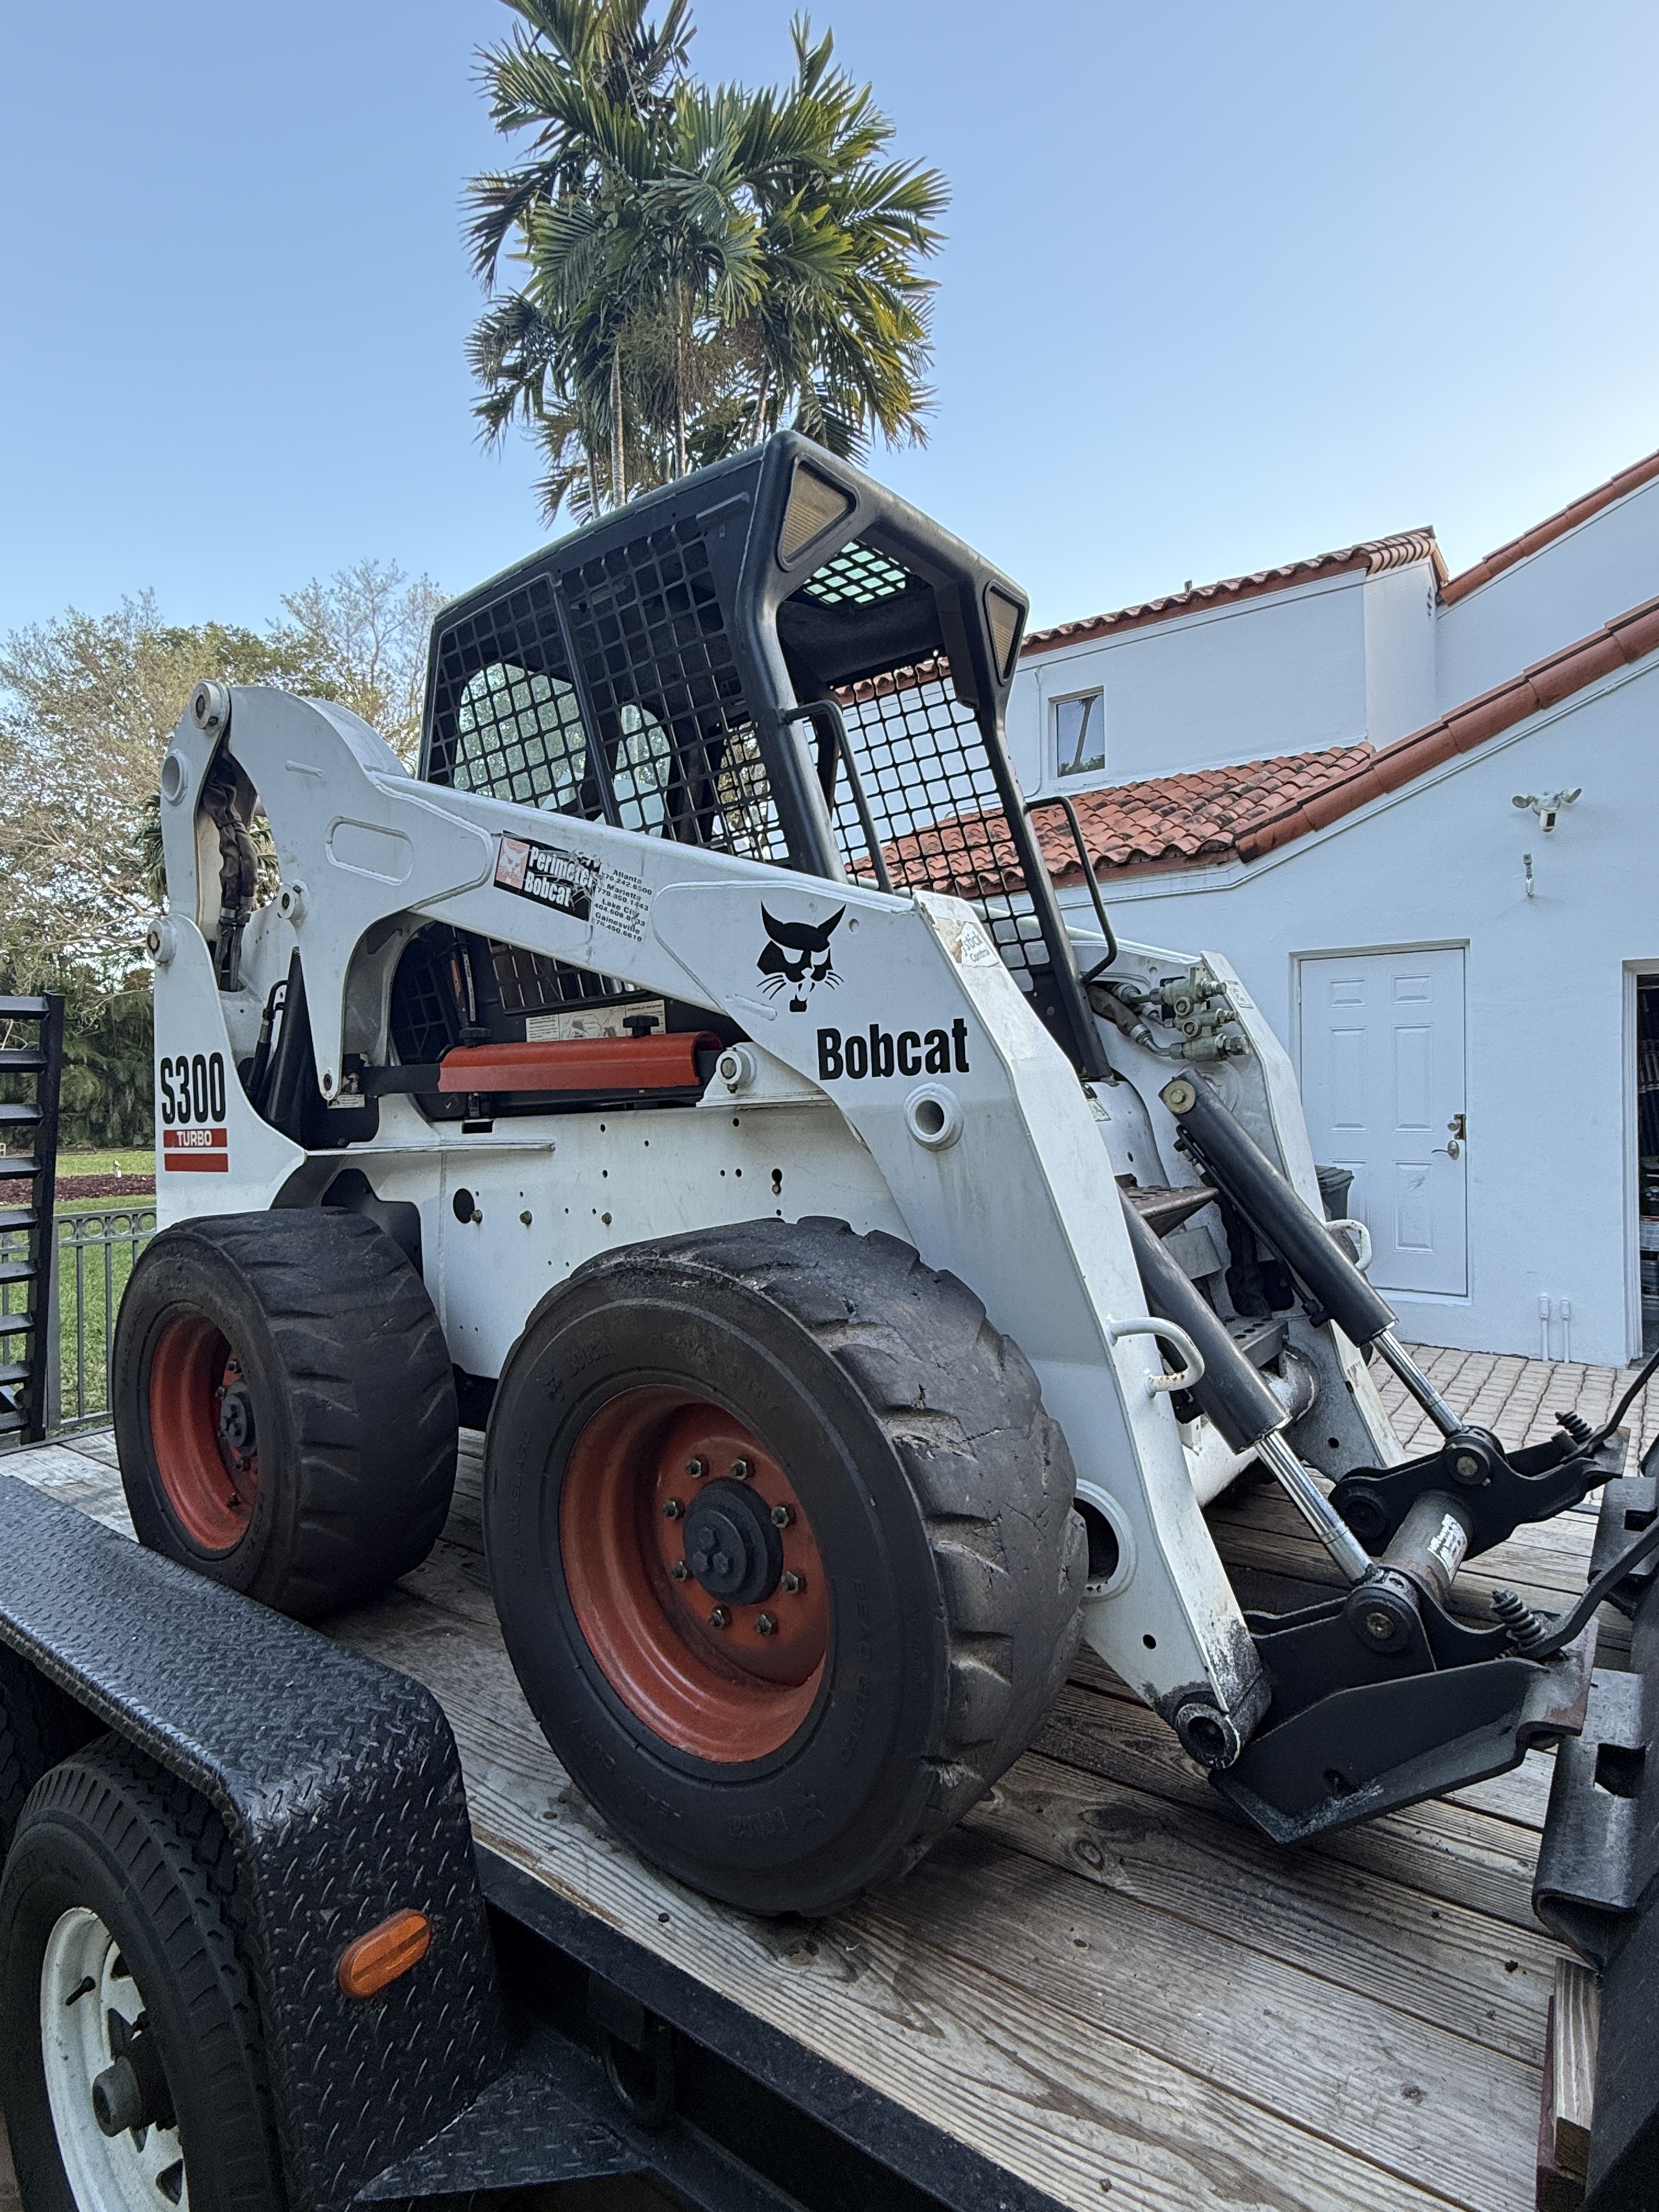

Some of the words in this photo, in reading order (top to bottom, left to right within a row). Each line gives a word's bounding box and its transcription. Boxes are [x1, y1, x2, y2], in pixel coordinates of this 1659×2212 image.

[529, 847, 595, 888] Perimeter
[613, 869, 642, 884] Atlanta
[524, 871, 572, 907] Bobcat
[607, 883, 641, 901] Marietta
[594, 903, 645, 926] 404.608.833
[602, 898, 621, 911] Lake
[624, 906, 640, 919] City
[595, 912, 640, 935] Gainesville
[817, 1018, 970, 1081] Bobcat
[160, 1052, 226, 1124] S300
[176, 1130, 212, 1147] TURBO
